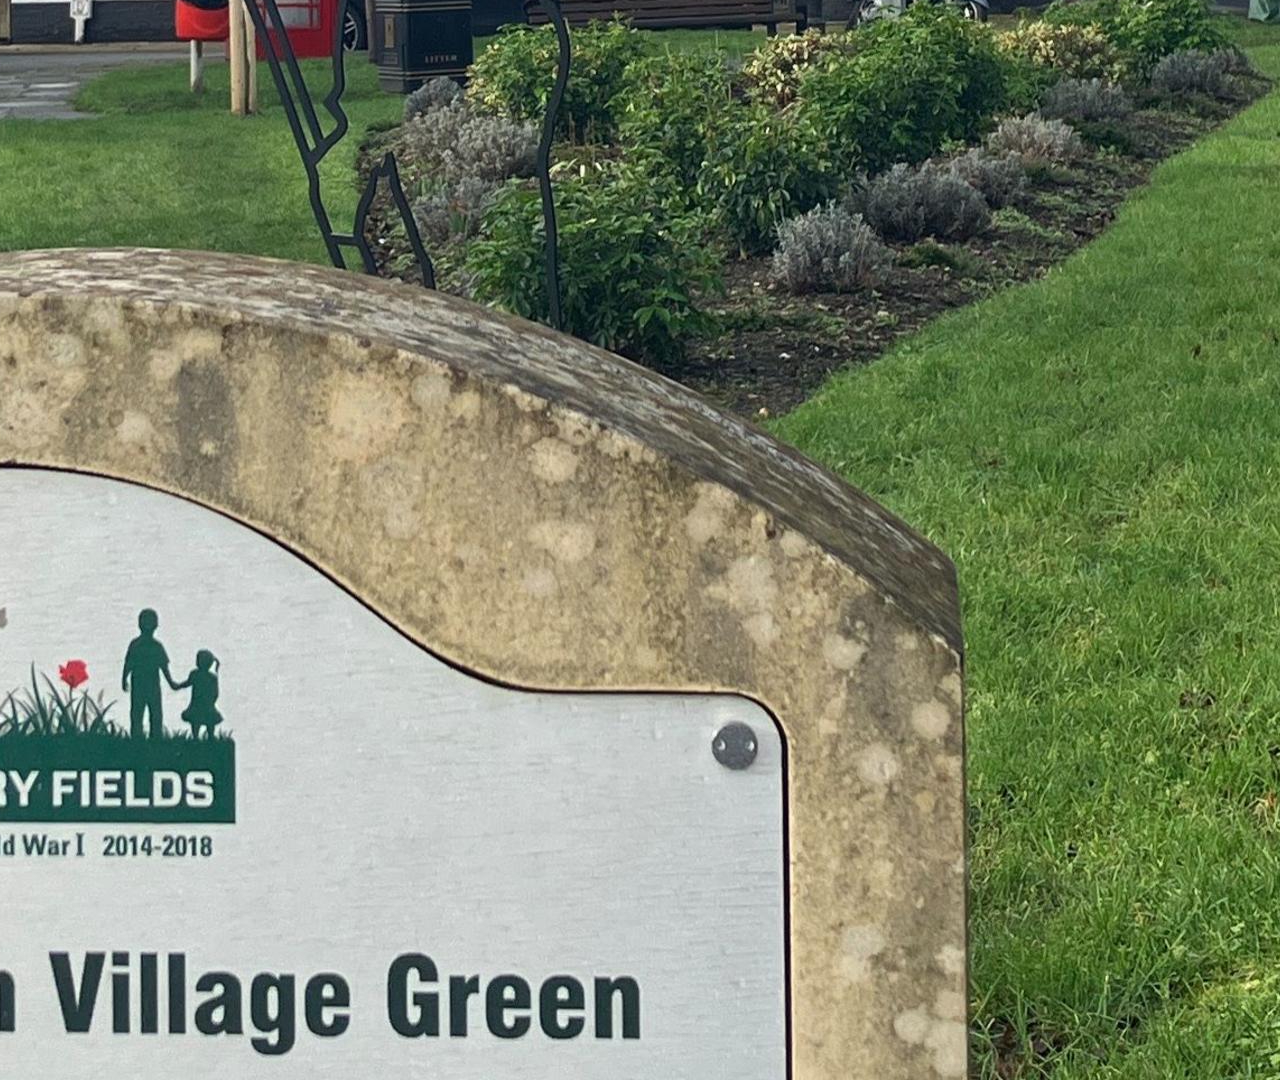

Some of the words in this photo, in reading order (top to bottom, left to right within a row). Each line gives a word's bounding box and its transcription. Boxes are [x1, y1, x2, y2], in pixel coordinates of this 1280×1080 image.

[51, 770, 214, 808] FIELDS
[22, 833, 70, 856] War
[76, 832, 84, 856] I
[103, 834, 213, 857] 2014-2018
[48, 949, 351, 1056] Village
[386, 951, 642, 1040] Green
